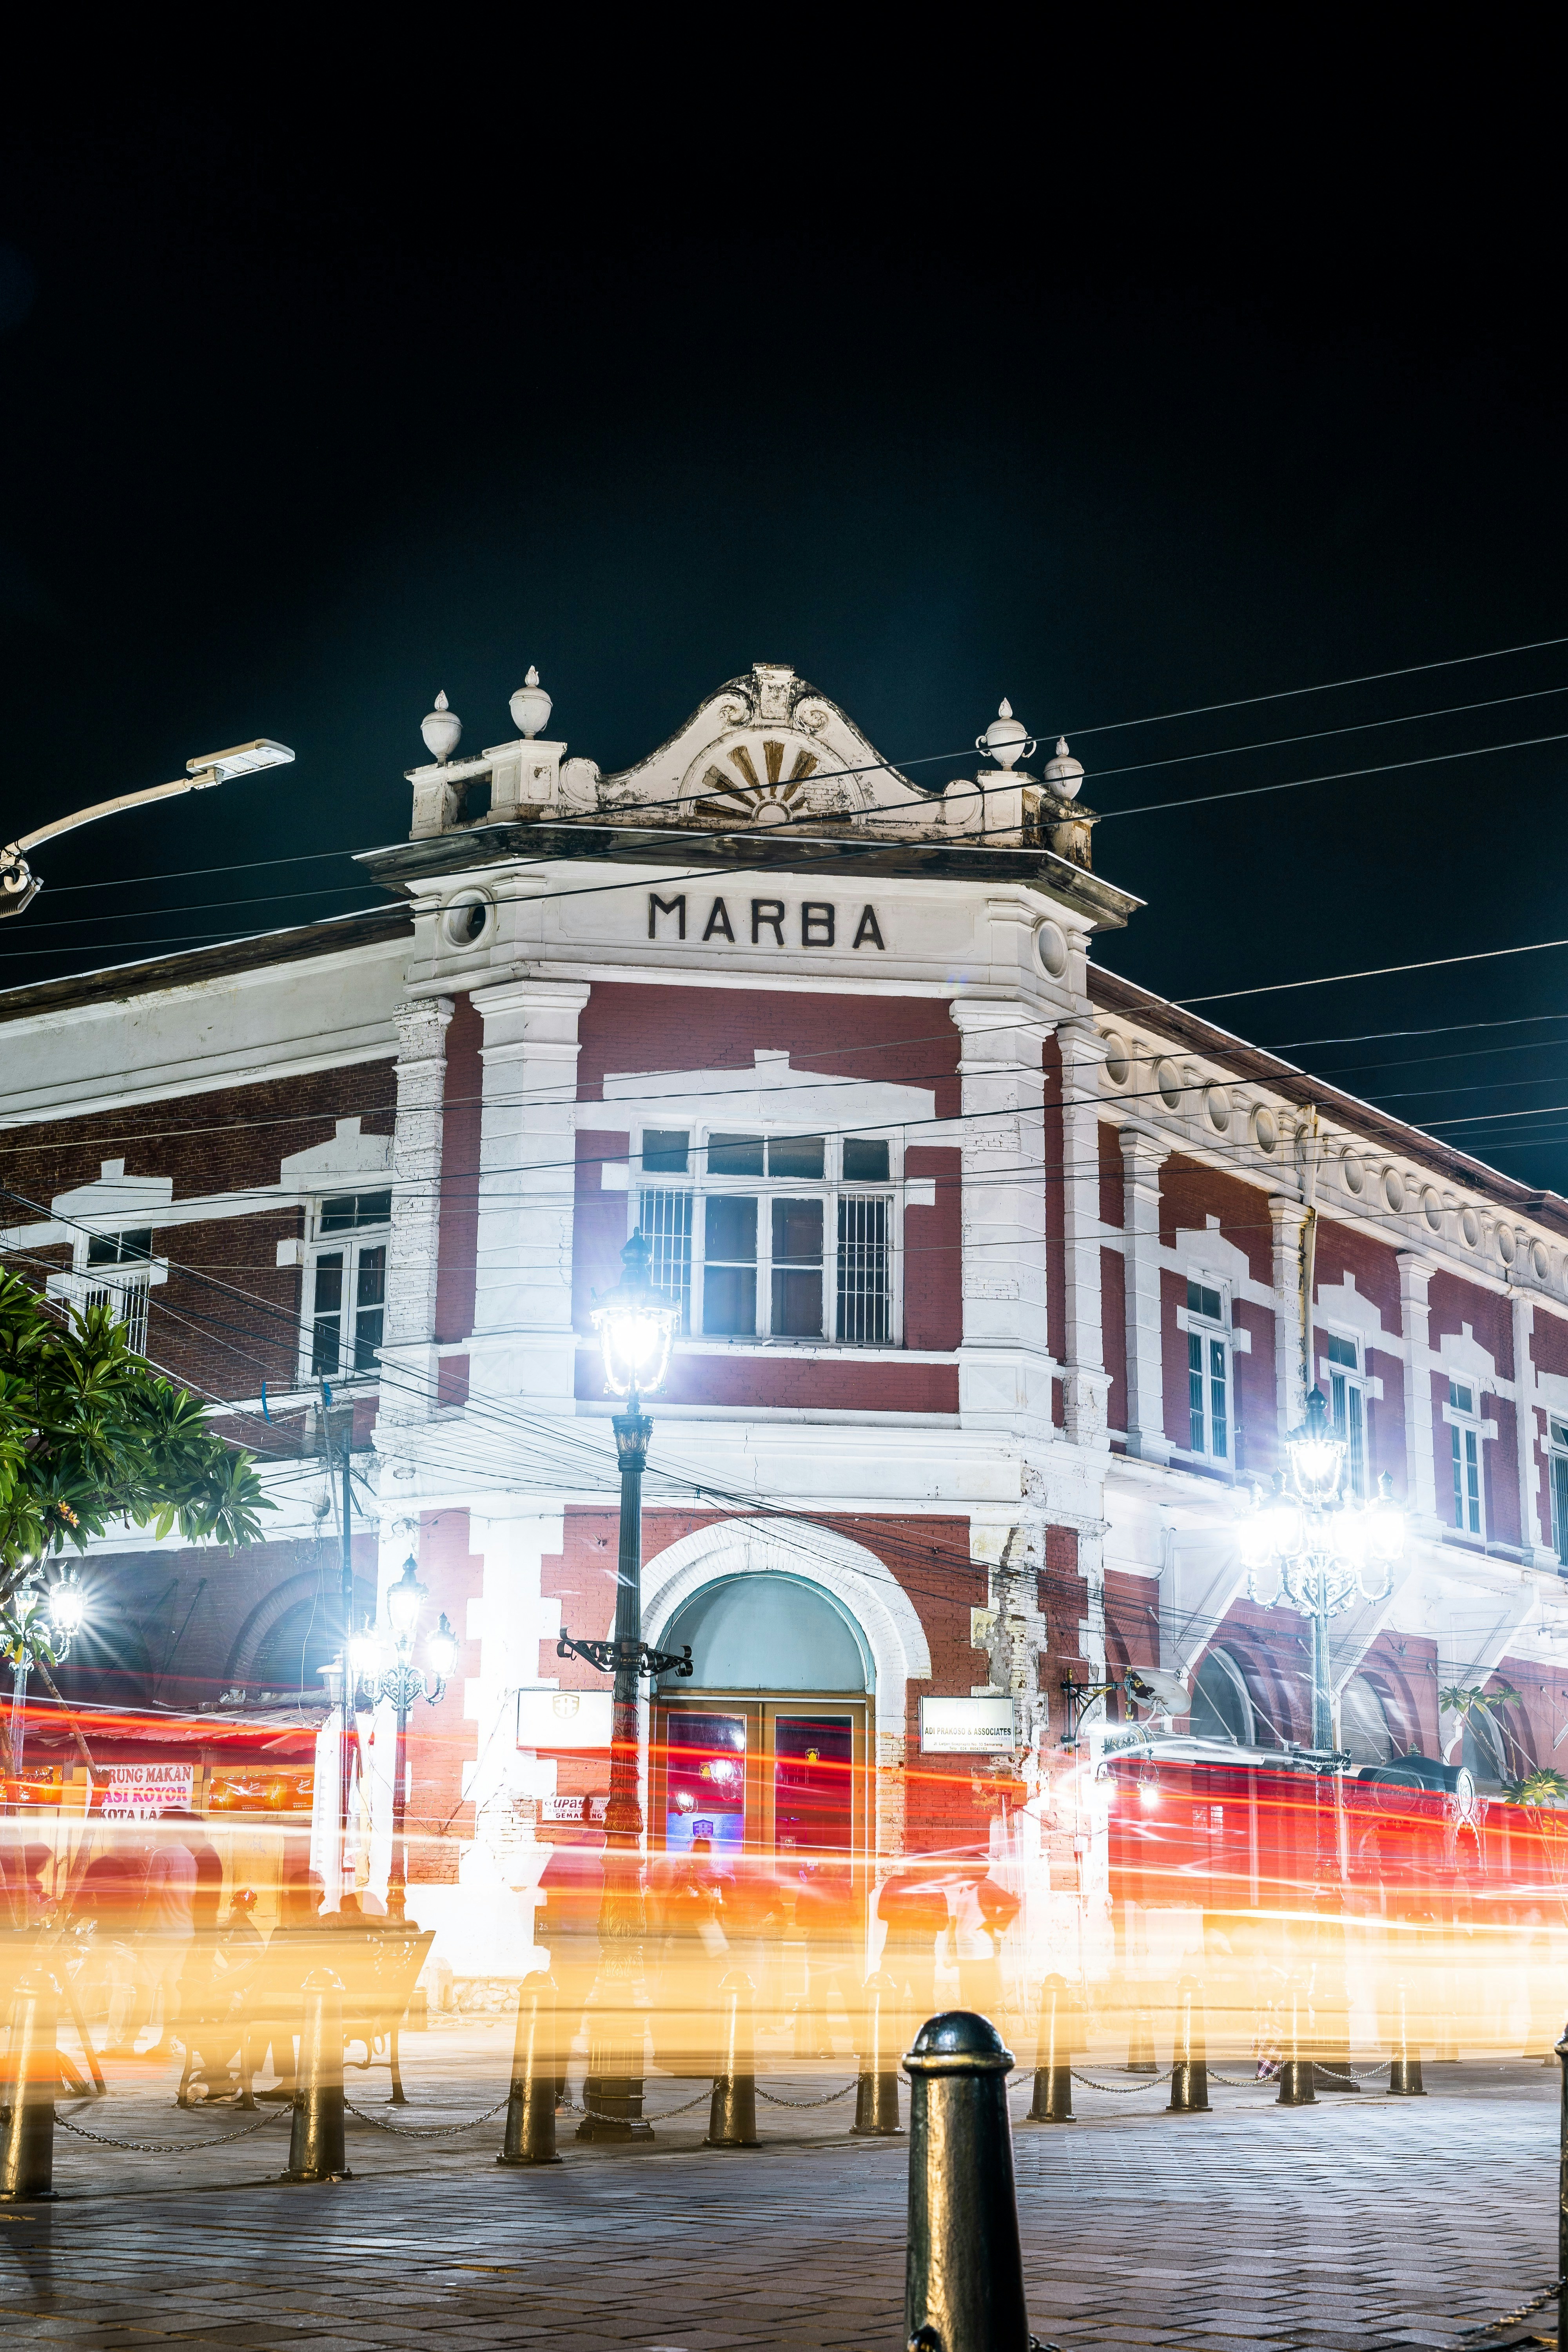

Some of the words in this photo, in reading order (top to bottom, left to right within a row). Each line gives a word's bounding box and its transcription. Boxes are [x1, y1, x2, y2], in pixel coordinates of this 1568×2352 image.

[648, 893, 885, 950] MARBA
[974, 1728, 1011, 1736] ASSOCIATES
[91, 1768, 143, 1783] RUNG
[145, 1767, 191, 1782] MAKAN
[132, 1786, 187, 1802] KOYOR
[99, 1807, 136, 1822] KOTA
